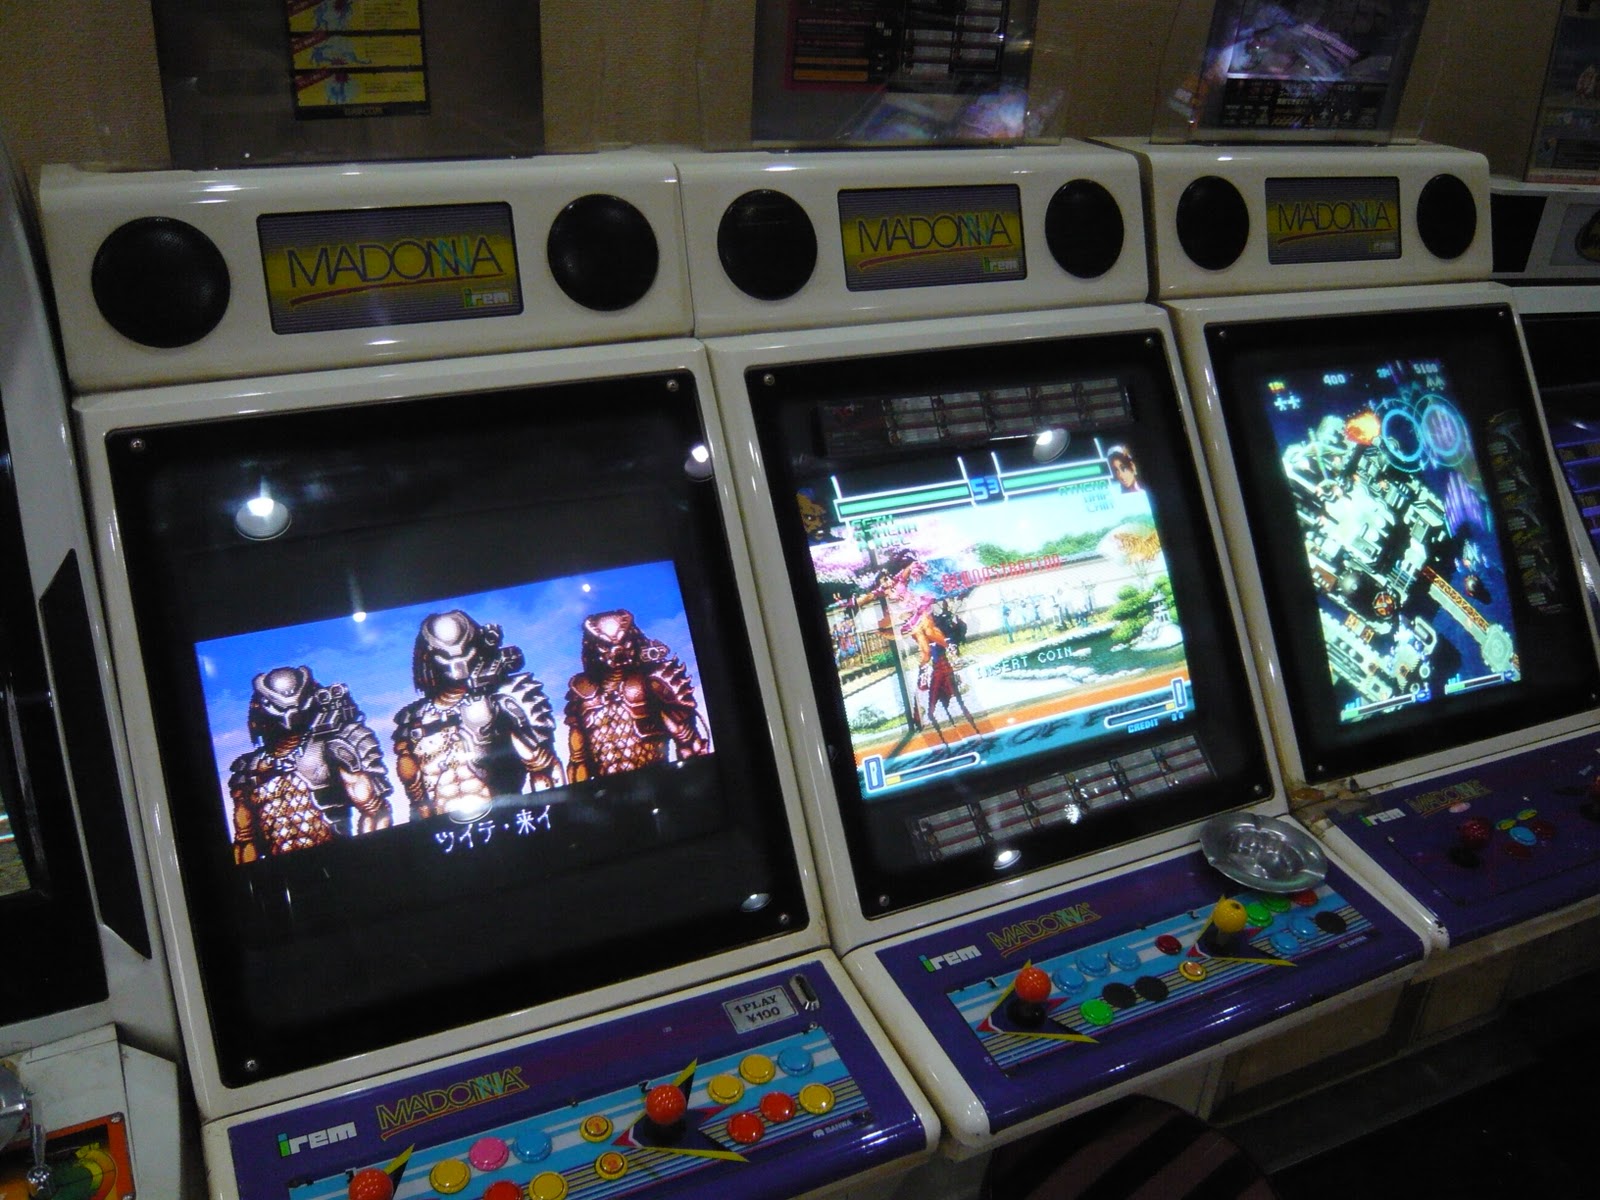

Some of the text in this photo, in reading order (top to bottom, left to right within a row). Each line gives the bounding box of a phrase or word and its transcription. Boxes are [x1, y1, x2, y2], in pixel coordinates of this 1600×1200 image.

[857, 213, 1013, 252] MADONNA
[1277, 202, 1394, 232] MADONNA
[287, 236, 505, 288] MADONNA
[464, 288, 510, 307] irem
[1323, 374, 1346, 387] 400
[970, 476, 1000, 501] 53
[977, 646, 1073, 679] INSERT COIN
[1127, 718, 1159, 734] CREDIT
[434, 804, 552, 853] ツイテ・来イ
[986, 903, 1100, 951] MADONNA
[918, 944, 983, 974] irem
[746, 1006, 781, 1024] ¥100
[375, 1067, 528, 1130] MADONNA
[278, 1120, 357, 1158] irem
